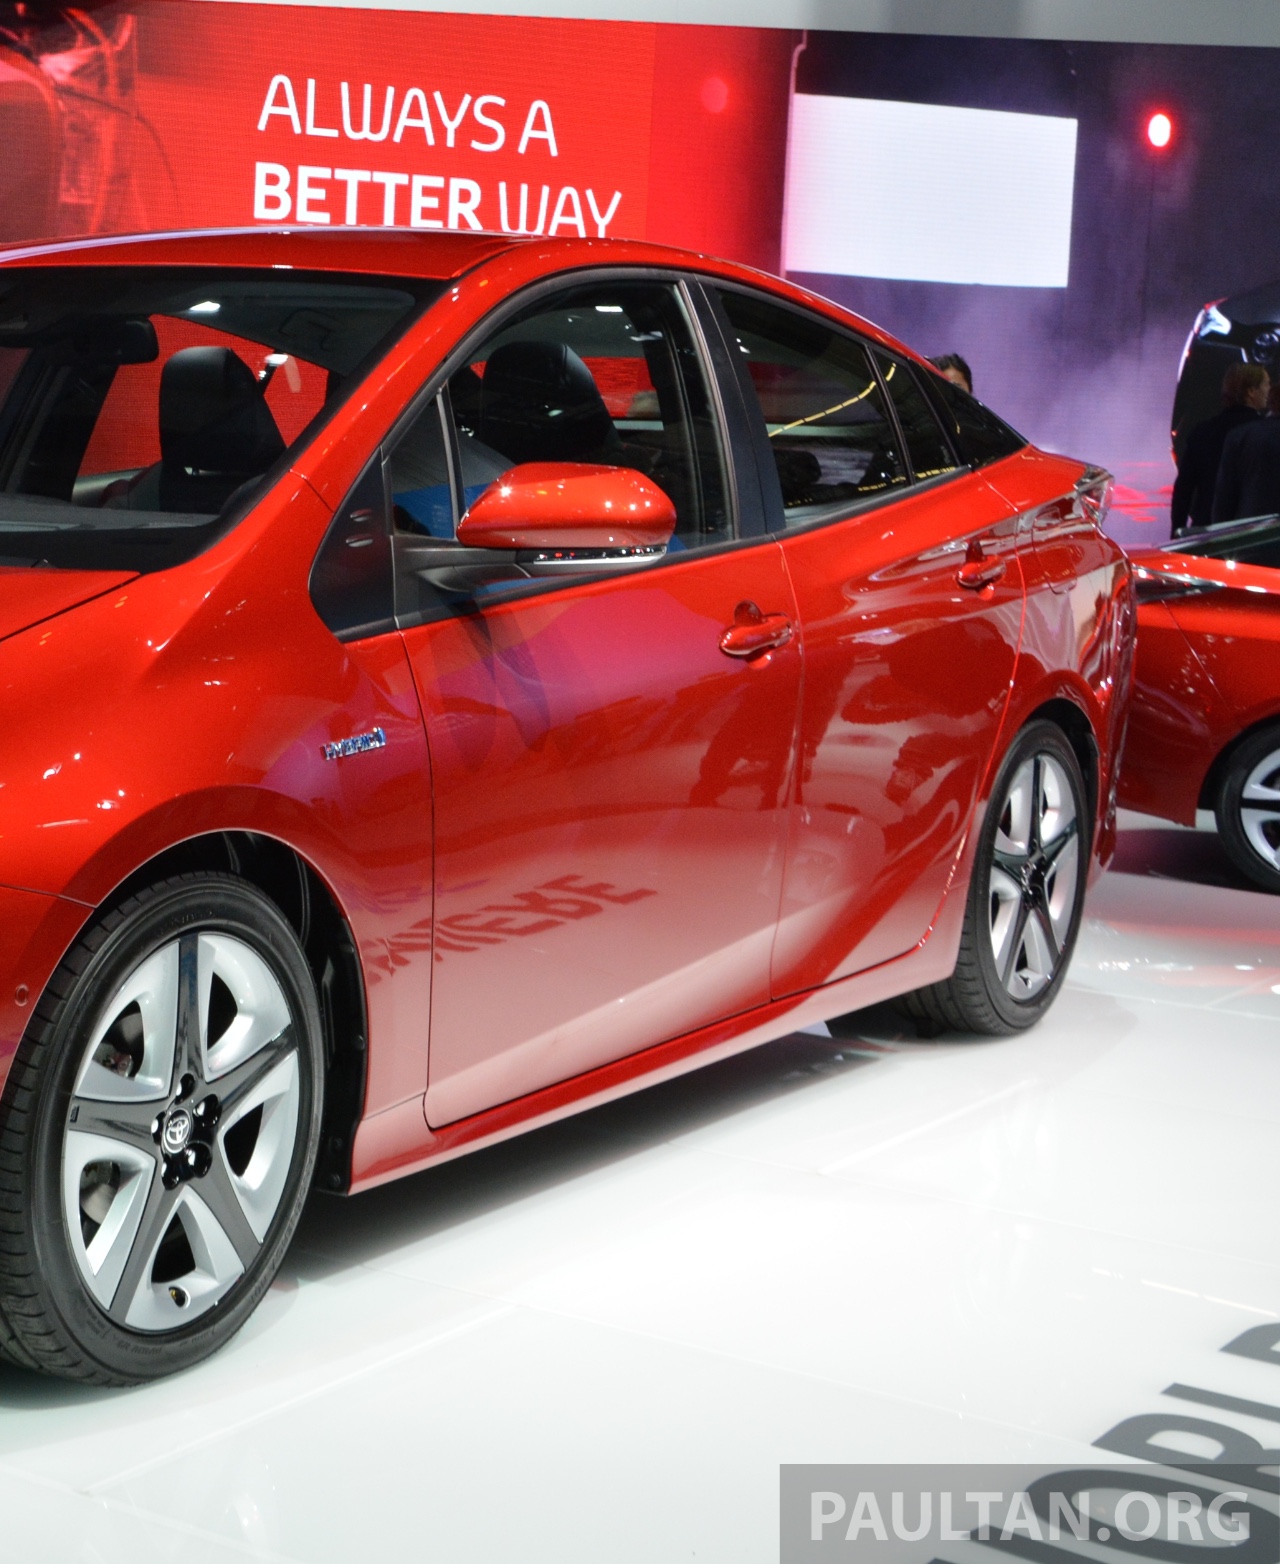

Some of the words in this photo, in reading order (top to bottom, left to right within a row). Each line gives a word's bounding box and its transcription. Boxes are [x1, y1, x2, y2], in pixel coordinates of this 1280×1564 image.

[257, 73, 506, 153] ALWAYS
[518, 99, 558, 157] A
[253, 161, 482, 230] BETTER
[498, 180, 622, 238] WAY
